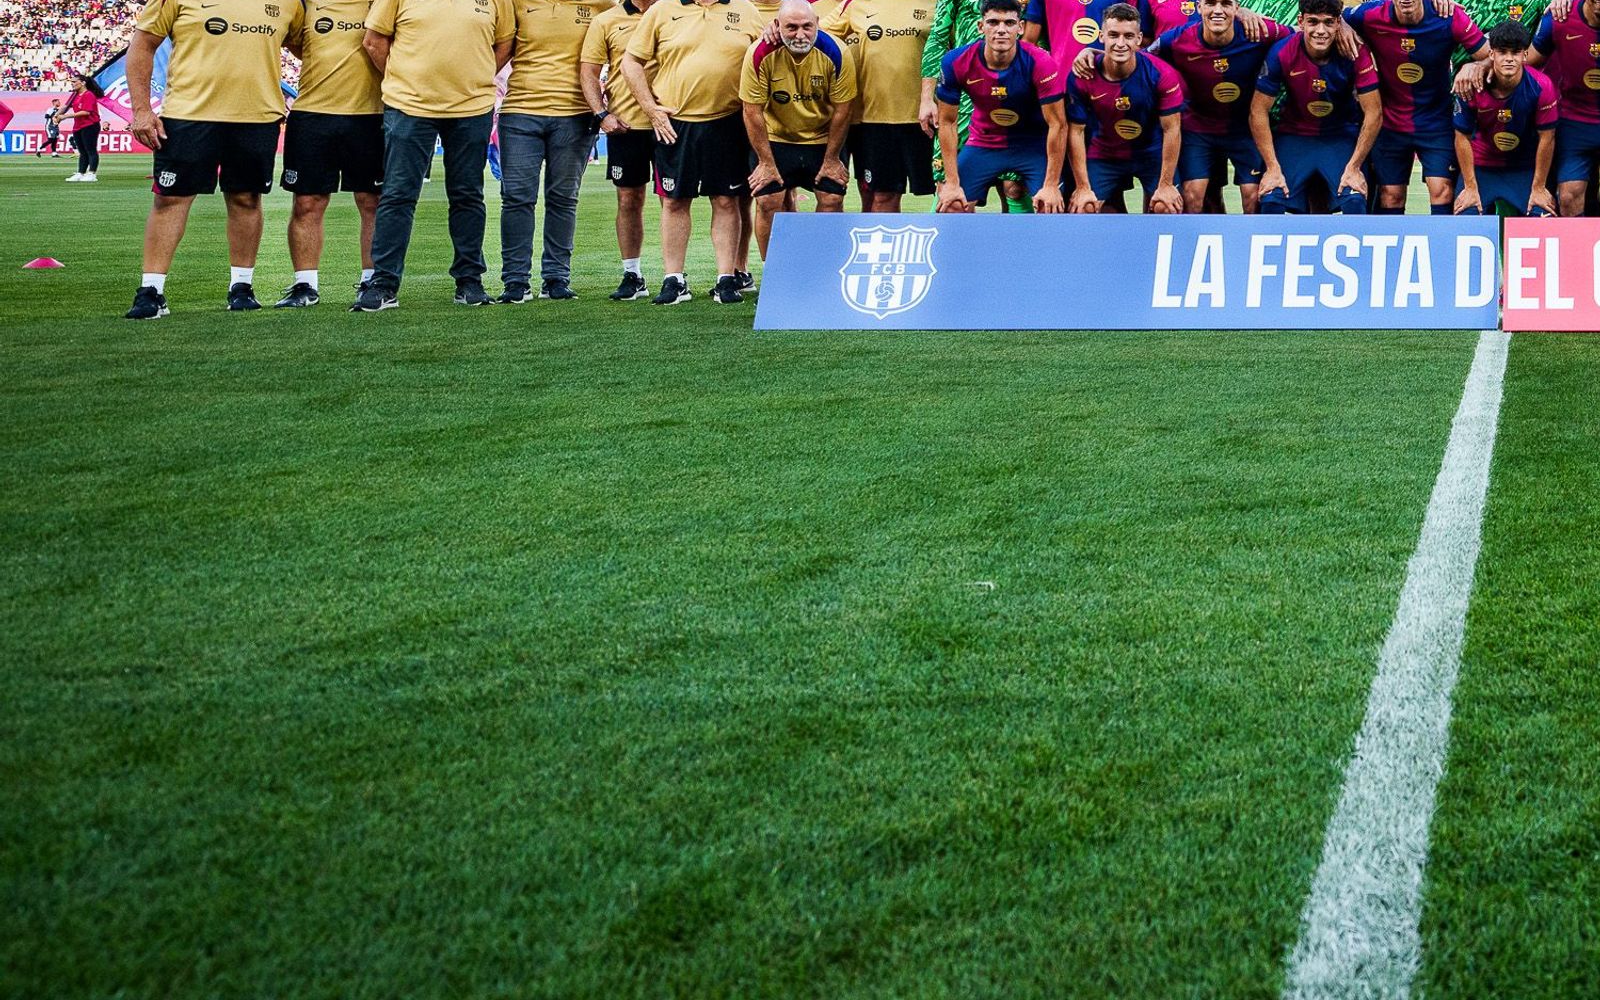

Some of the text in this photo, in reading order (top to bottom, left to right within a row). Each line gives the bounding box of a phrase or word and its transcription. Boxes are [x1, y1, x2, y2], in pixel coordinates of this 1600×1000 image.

[231, 22, 277, 36] Spotify
[337, 21, 366, 31] Spot
[885, 27, 922, 37] Spotify
[55, 134, 132, 152] GAPER
[870, 263, 906, 275] FCB
[1152, 235, 1225, 308] LA
[1246, 235, 1434, 308] FESTA
[1455, 235, 1575, 310] DEL
